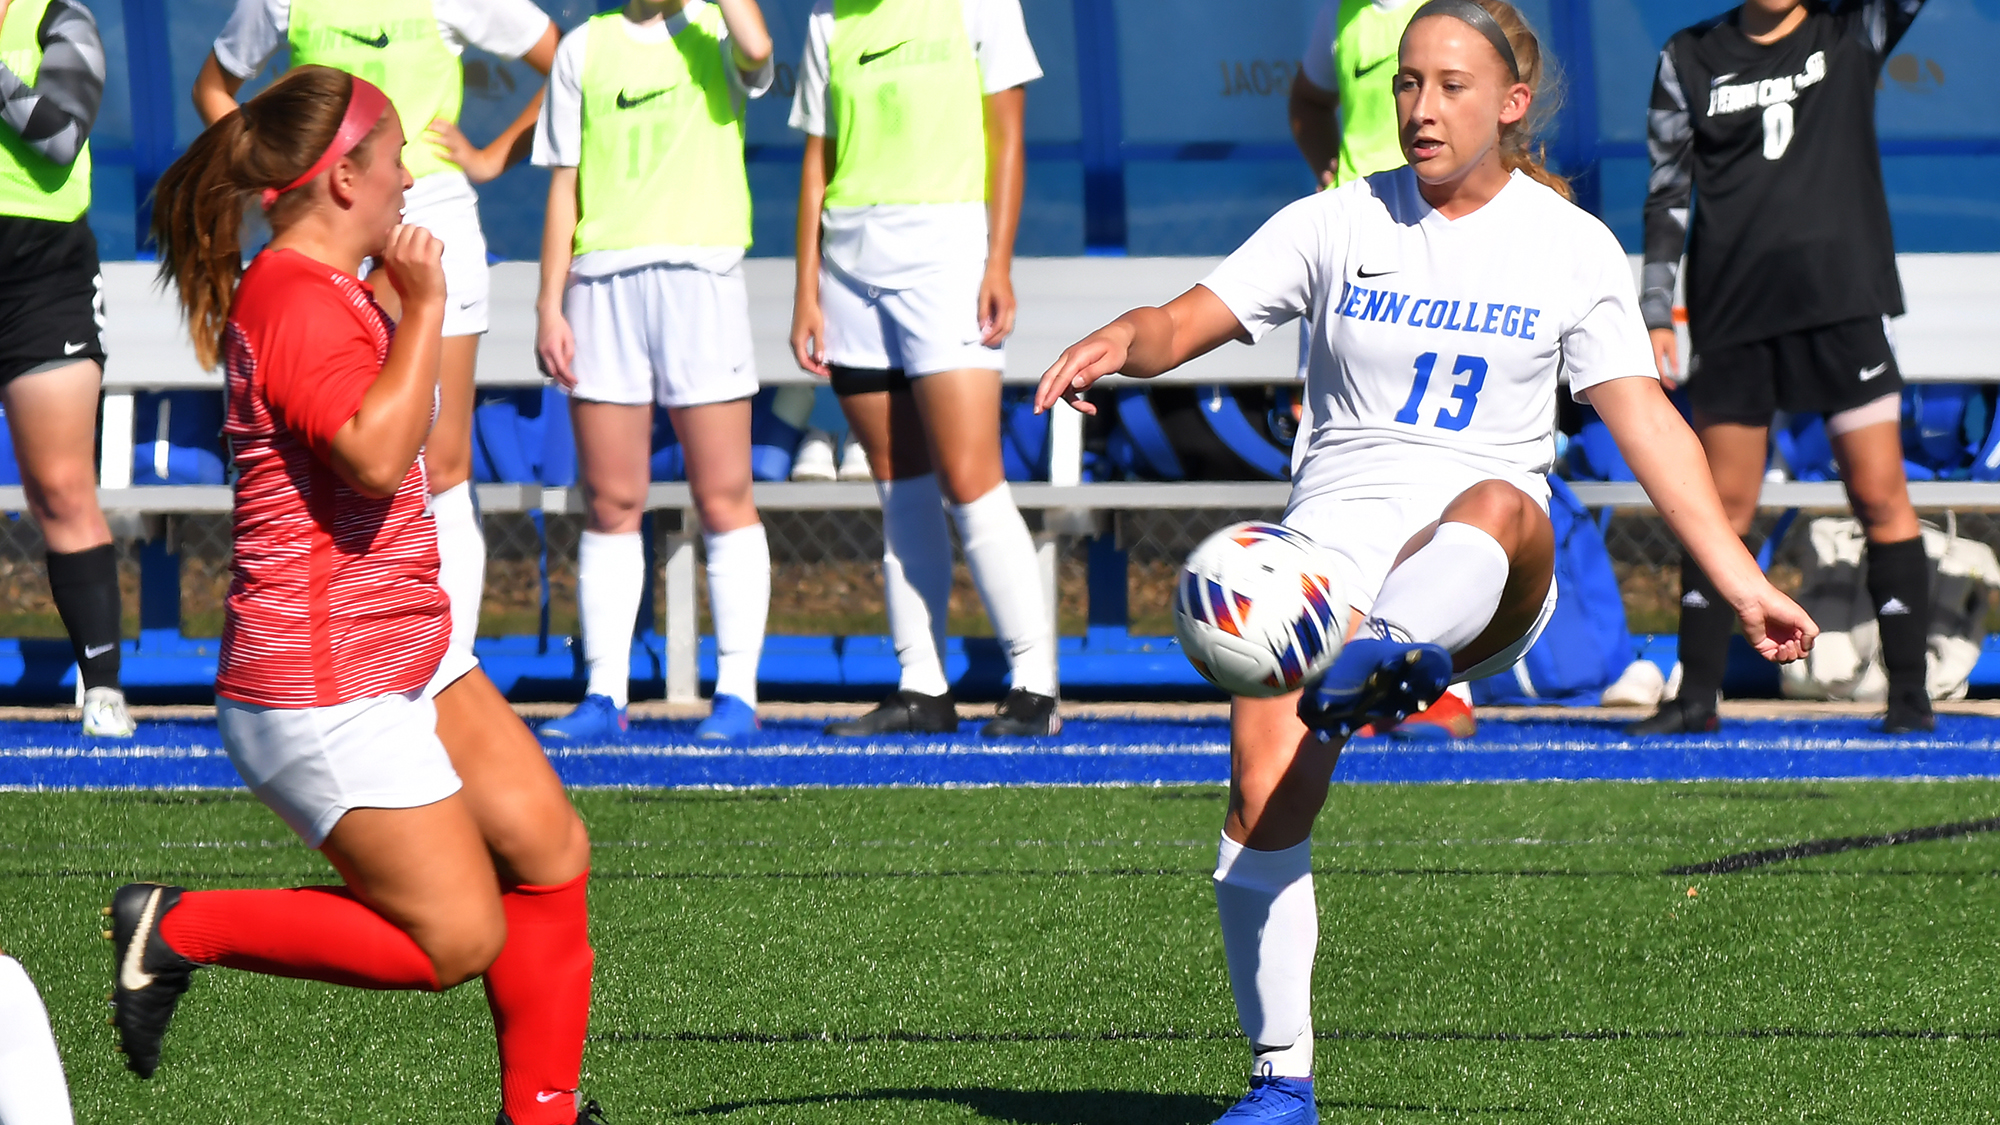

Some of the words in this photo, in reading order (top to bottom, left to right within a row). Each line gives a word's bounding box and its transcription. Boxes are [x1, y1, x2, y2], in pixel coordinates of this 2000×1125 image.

[1762, 101, 1795, 160] 0
[1407, 298, 1541, 341] COLLEGE
[1394, 351, 1489, 432] 13
